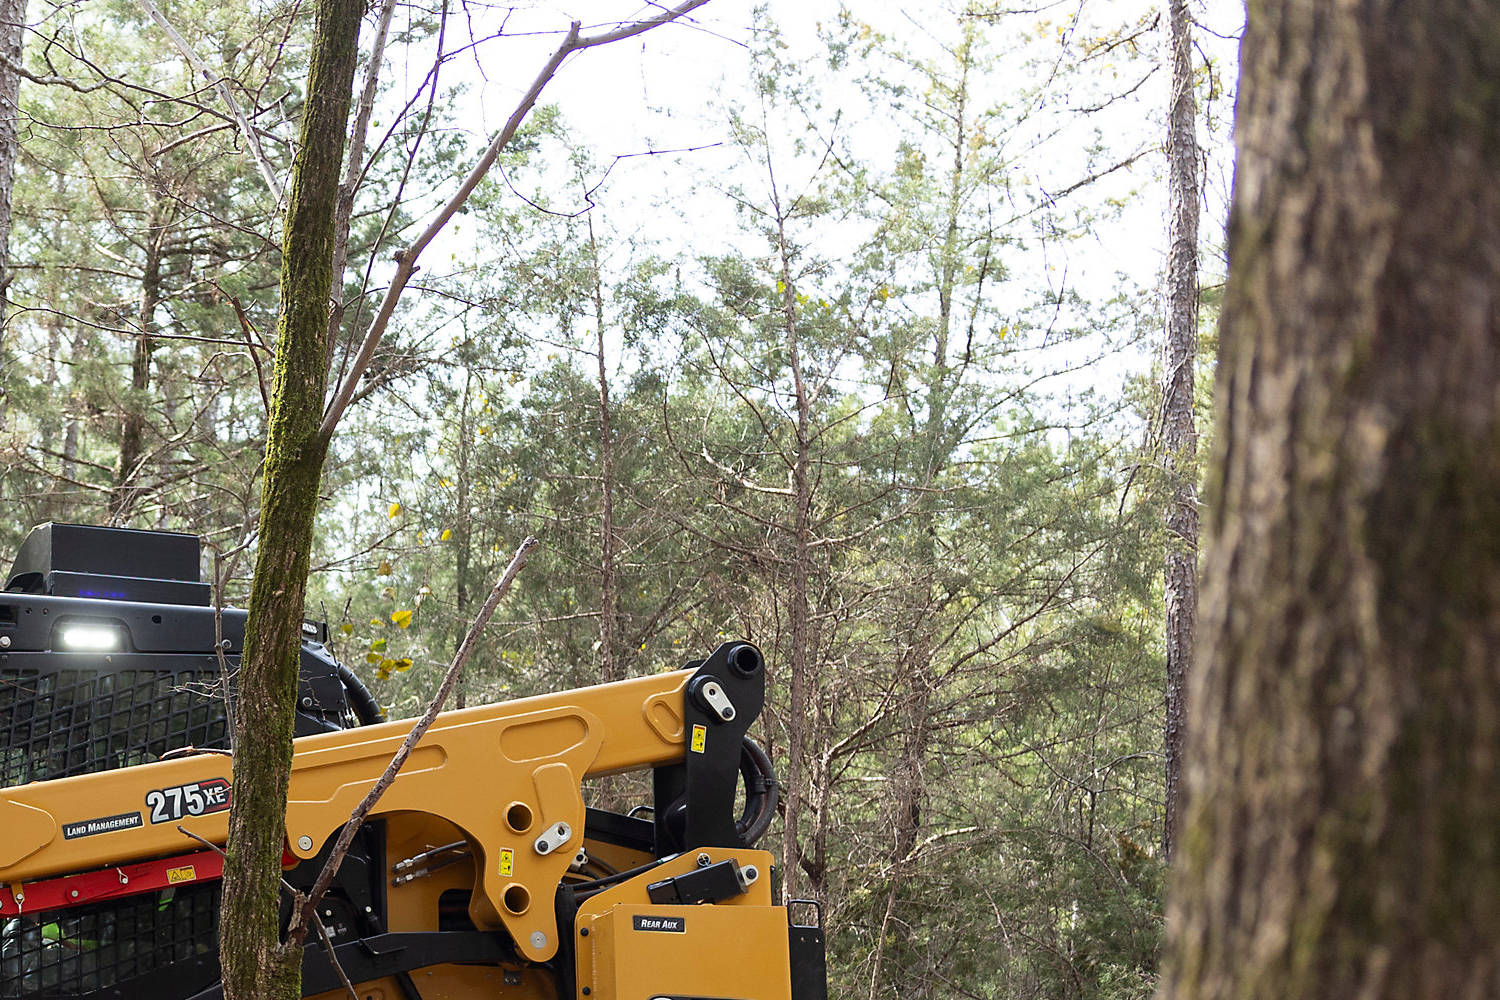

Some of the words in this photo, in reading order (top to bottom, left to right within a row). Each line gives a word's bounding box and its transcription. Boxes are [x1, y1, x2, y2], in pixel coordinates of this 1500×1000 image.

[67, 826, 87, 837] LAND
[88, 815, 139, 832] MANAGEMENT
[641, 919, 660, 928] REAR
[661, 920, 678, 929] AUX
